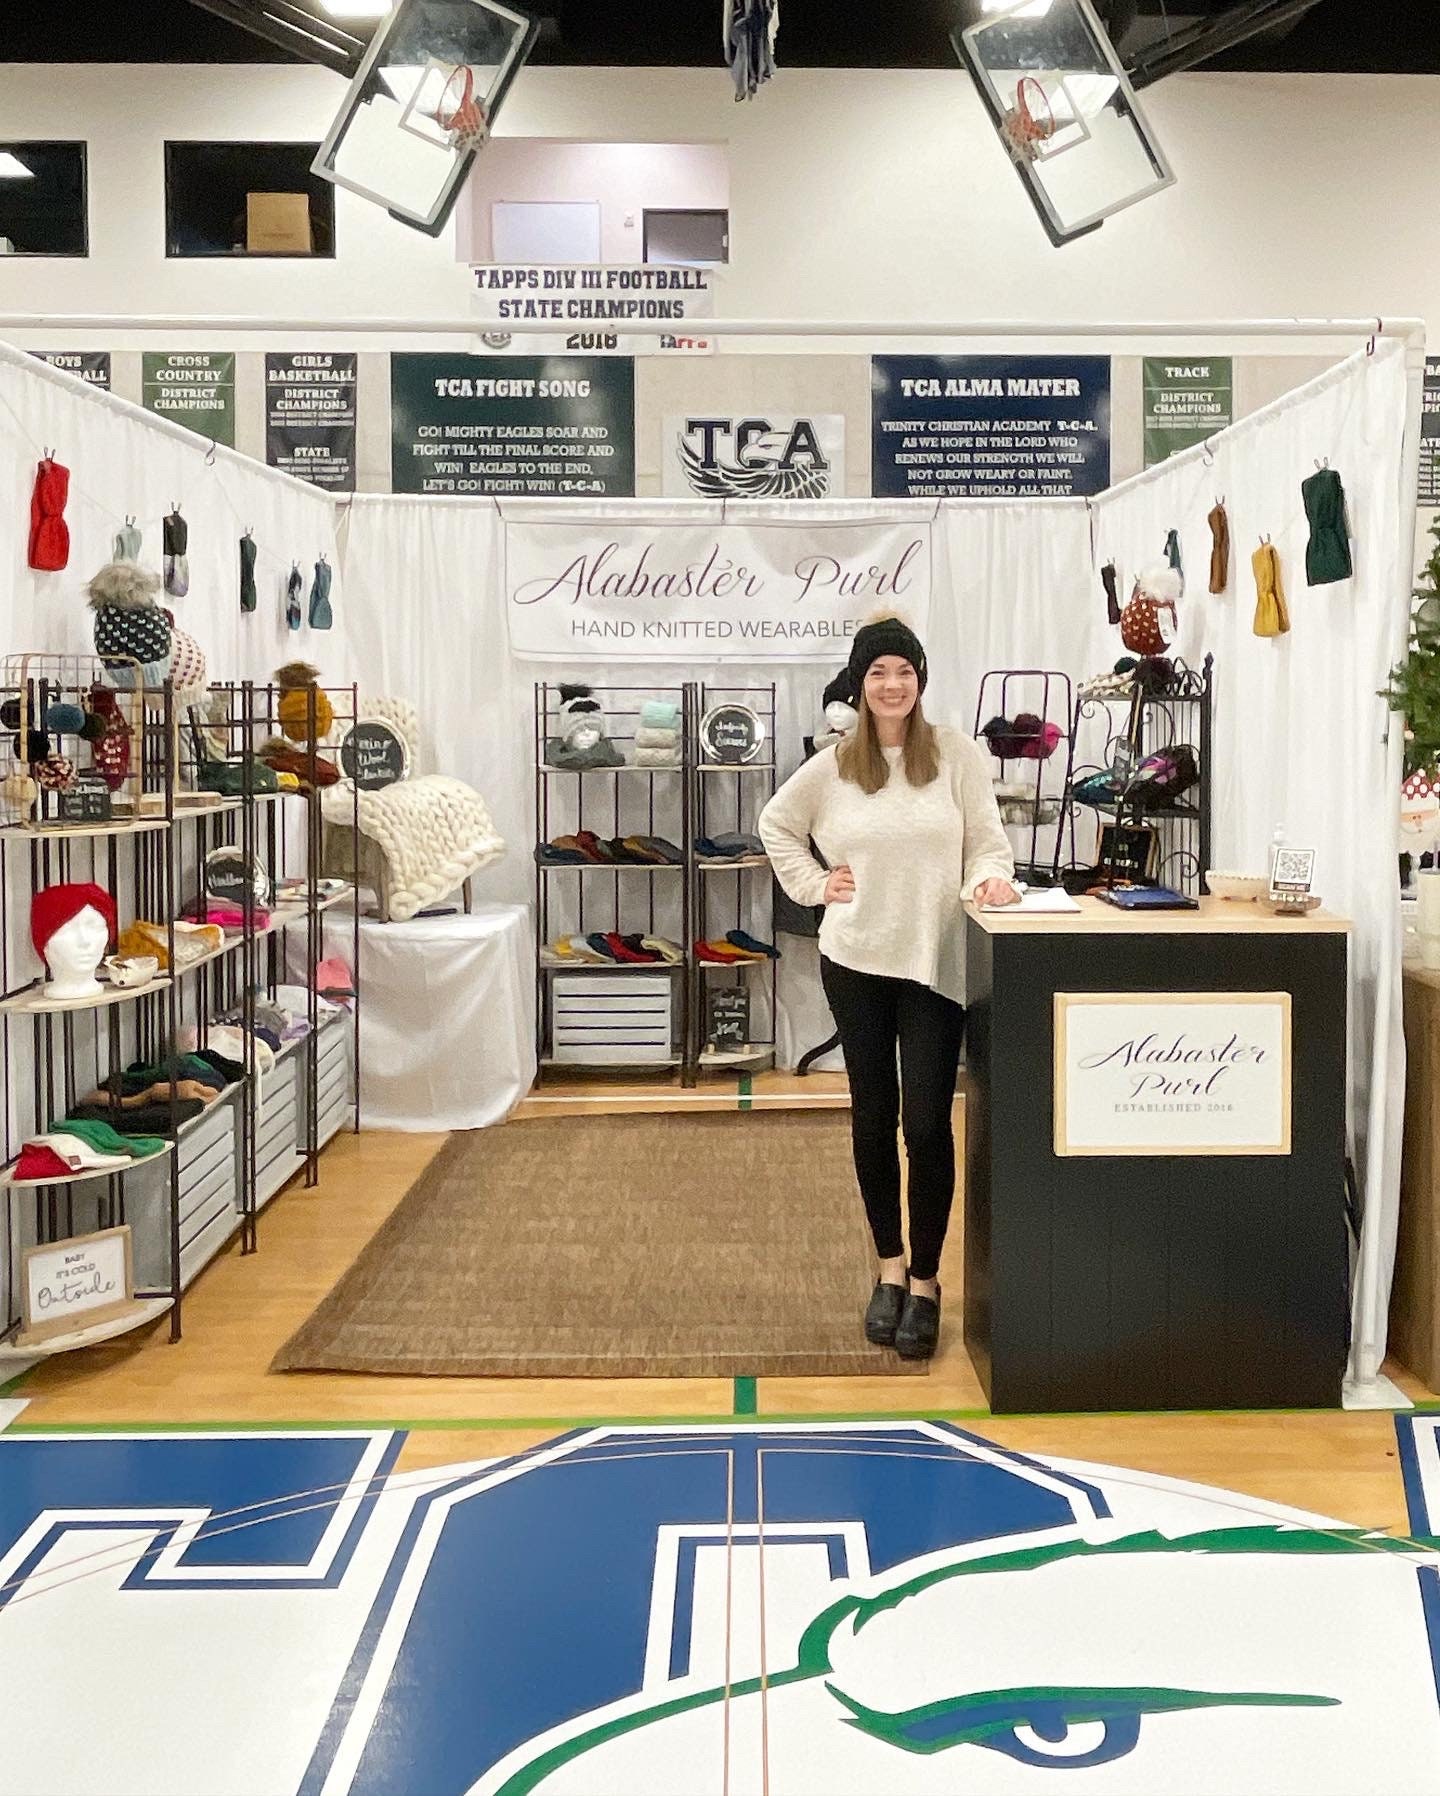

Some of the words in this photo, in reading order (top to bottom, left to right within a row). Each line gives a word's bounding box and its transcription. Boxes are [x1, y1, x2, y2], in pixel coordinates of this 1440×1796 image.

[474, 269, 539, 290] TAPPS
[543, 269, 576, 290] DIV
[581, 269, 602, 290] III
[606, 269, 708, 290] FOOTBALL
[499, 299, 563, 319] STATE
[567, 299, 684, 319] CHAMPIONS
[168, 355, 210, 367] CROSS
[291, 355, 333, 367] GIRLS
[156, 369, 222, 382] COUNTRY
[268, 369, 356, 382] BASKETBALL
[1164, 366, 1210, 378] TRACK
[161, 387, 216, 399] DISTRICT
[284, 388, 339, 399] DISTRICT
[434, 378, 473, 398] TCA
[476, 378, 535, 398] FIGHT
[539, 378, 591, 398] SONG
[900, 378, 942, 397] TCA
[945, 378, 1004, 397] ALMA
[1007, 378, 1081, 397] MATER
[1160, 392, 1214, 403] DISTRICT
[154, 399, 225, 410] CHAMPIONS
[276, 400, 348, 410] CHAMPIONS
[1153, 403, 1222, 413] CHAMPIONS
[445, 426, 493, 438] MIGHTY
[496, 426, 543, 438] EAGLES
[546, 426, 579, 438] SOAR
[581, 426, 608, 438] AND
[880, 420, 926, 432] TRINITY
[928, 420, 990, 432] CHRISTIAN
[992, 420, 1052, 432] ACADEMY
[686, 417, 829, 470] TCA
[902, 436, 918, 448] AS
[919, 436, 939, 448] WE
[940, 436, 974, 448] HOPE
[975, 436, 988, 448] IN
[989, 436, 1013, 448] THE
[1015, 436, 1047, 448] LORD
[1048, 436, 1078, 448] WHO
[294, 447, 330, 457] STATE
[412, 444, 450, 456] FIGHT
[452, 444, 477, 456] TILL
[478, 444, 503, 456] THE
[505, 444, 541, 456] FINAL
[543, 444, 585, 456] SCORE
[587, 444, 614, 456] AND
[895, 453, 944, 464] RENEWS
[946, 453, 971, 464] OUR
[973, 453, 1034, 464] STRENGTH
[1035, 453, 1056, 464] WE
[1056, 453, 1085, 464] WILL
[469, 462, 516, 474] EAGLES
[518, 462, 536, 474] TO
[538, 462, 563, 474] THE
[908, 469, 933, 480] NOT
[935, 469, 972, 480] GROW
[974, 469, 1017, 480] WEARY
[1018, 469, 1035, 480] OR
[908, 484, 946, 496] WHILE
[947, 484, 967, 496] WE
[969, 484, 1017, 496] UPHOLD
[1018, 484, 1040, 496] ALL
[1041, 484, 1072, 496] THAT
[513, 541, 765, 605] Alabaster
[794, 539, 924, 603] Purl
[571, 619, 636, 638] HAND
[643, 619, 733, 638] KNITTED
[1078, 1033, 1272, 1069] Alabaster
[1130, 1065, 1231, 1100] Purl
[1114, 1103, 1202, 1113] ESTABLISHED
[65, 1253, 86, 1265] BABY
